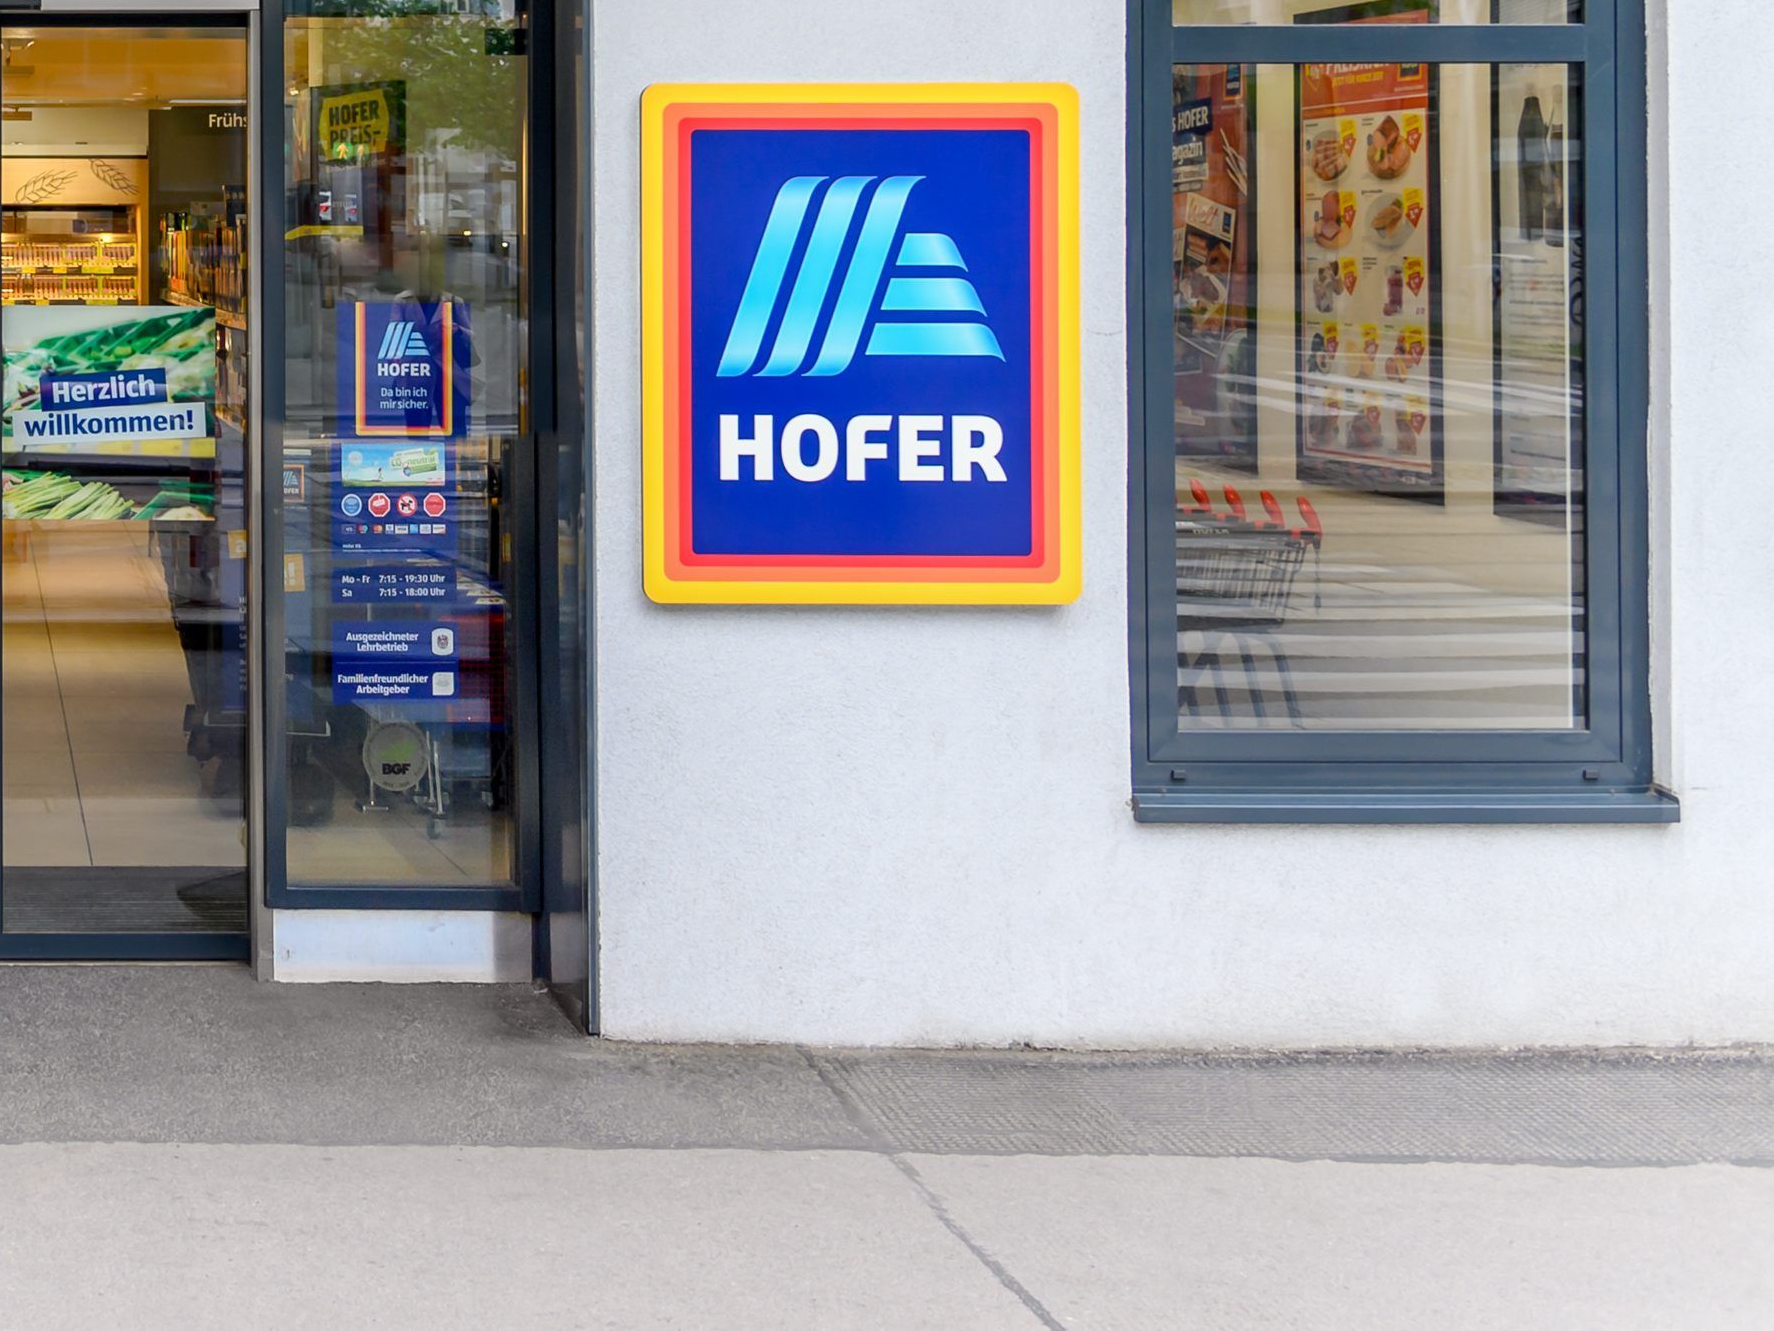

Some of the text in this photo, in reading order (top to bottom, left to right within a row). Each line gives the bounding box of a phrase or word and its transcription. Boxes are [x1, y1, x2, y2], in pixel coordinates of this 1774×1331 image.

[328, 99, 381, 127] HOFER
[1177, 106, 1209, 130] HOFER
[376, 362, 432, 377] HOFER
[51, 373, 157, 404] Herzlich
[380, 386, 428, 397] Da bin ich
[379, 399, 430, 409] mir sicher.
[23, 408, 195, 438] willkommen!
[719, 413, 1008, 483] HOFER
[341, 575, 355, 584] Mo
[361, 575, 371, 584] Fr
[378, 574, 397, 583] 7:15
[405, 574, 429, 583] 19:30
[429, 573, 446, 583] Uhr
[341, 588, 353, 597] Sa
[378, 588, 397, 597] 7:15
[405, 588, 429, 596] 18:00
[429, 587, 446, 596] Uhr
[345, 630, 419, 643] Ausgezeichneter
[356, 642, 409, 652] Lehrbetrieb
[337, 673, 429, 684] Familienfreundlicher
[356, 684, 410, 696] Arbeitgeber
[381, 762, 412, 775] BGF
